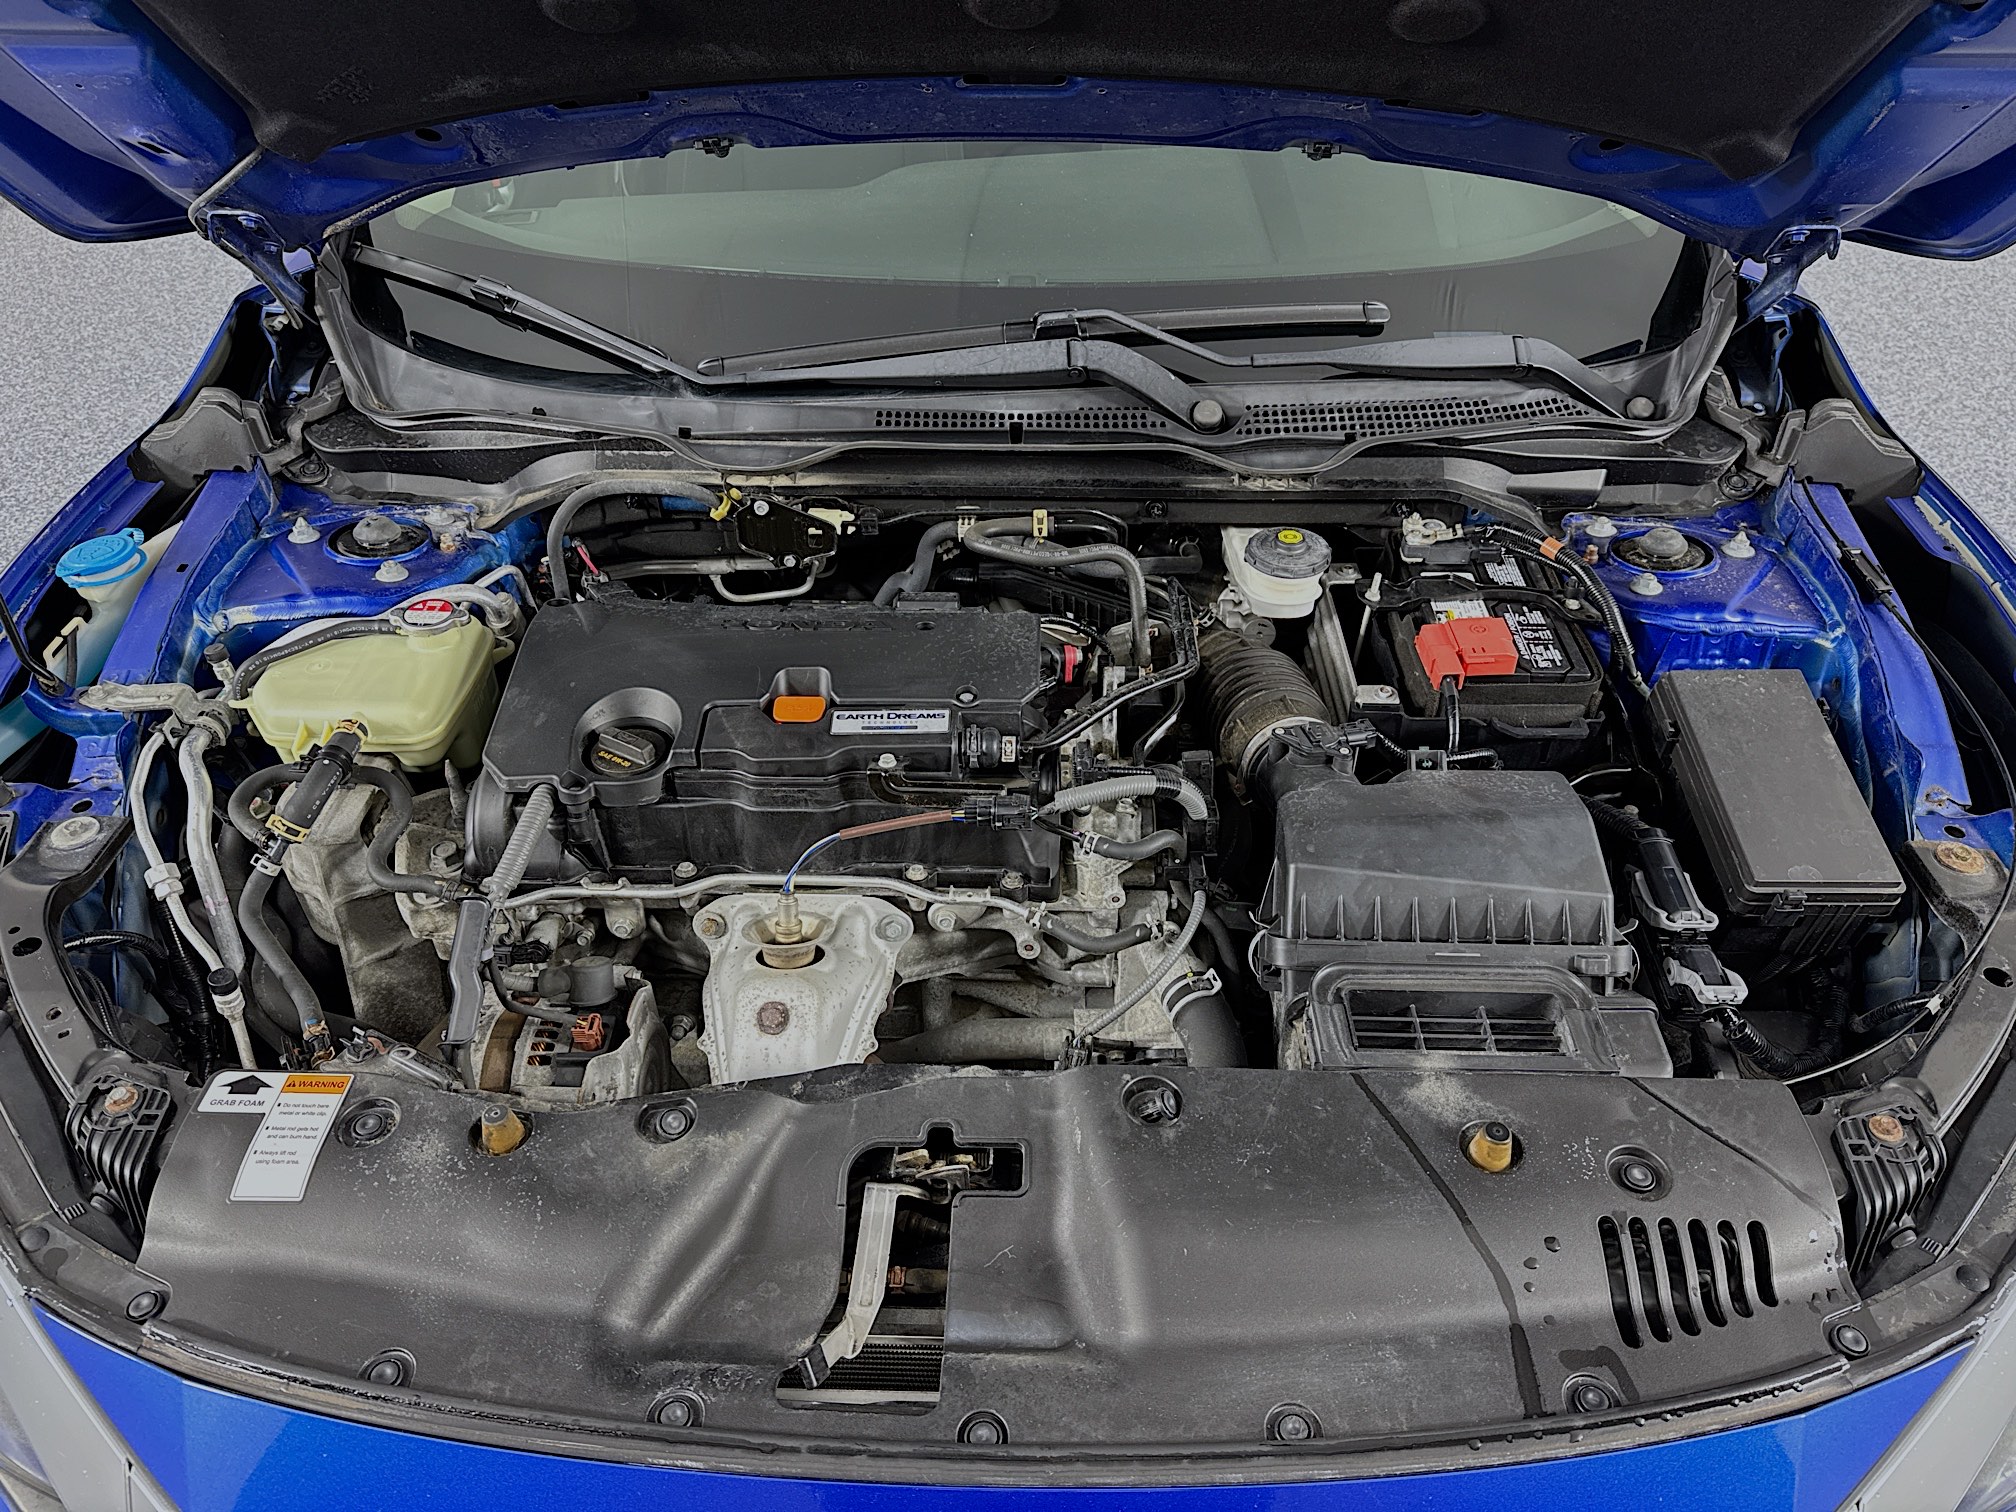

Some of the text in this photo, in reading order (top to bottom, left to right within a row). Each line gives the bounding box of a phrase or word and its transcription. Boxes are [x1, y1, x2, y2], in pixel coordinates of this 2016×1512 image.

[886, 712, 946, 720] DREAMS
[597, 750, 614, 760] SAE
[298, 1080, 345, 1088] WARNING
[209, 1098, 266, 1107] GRAB FOAM
